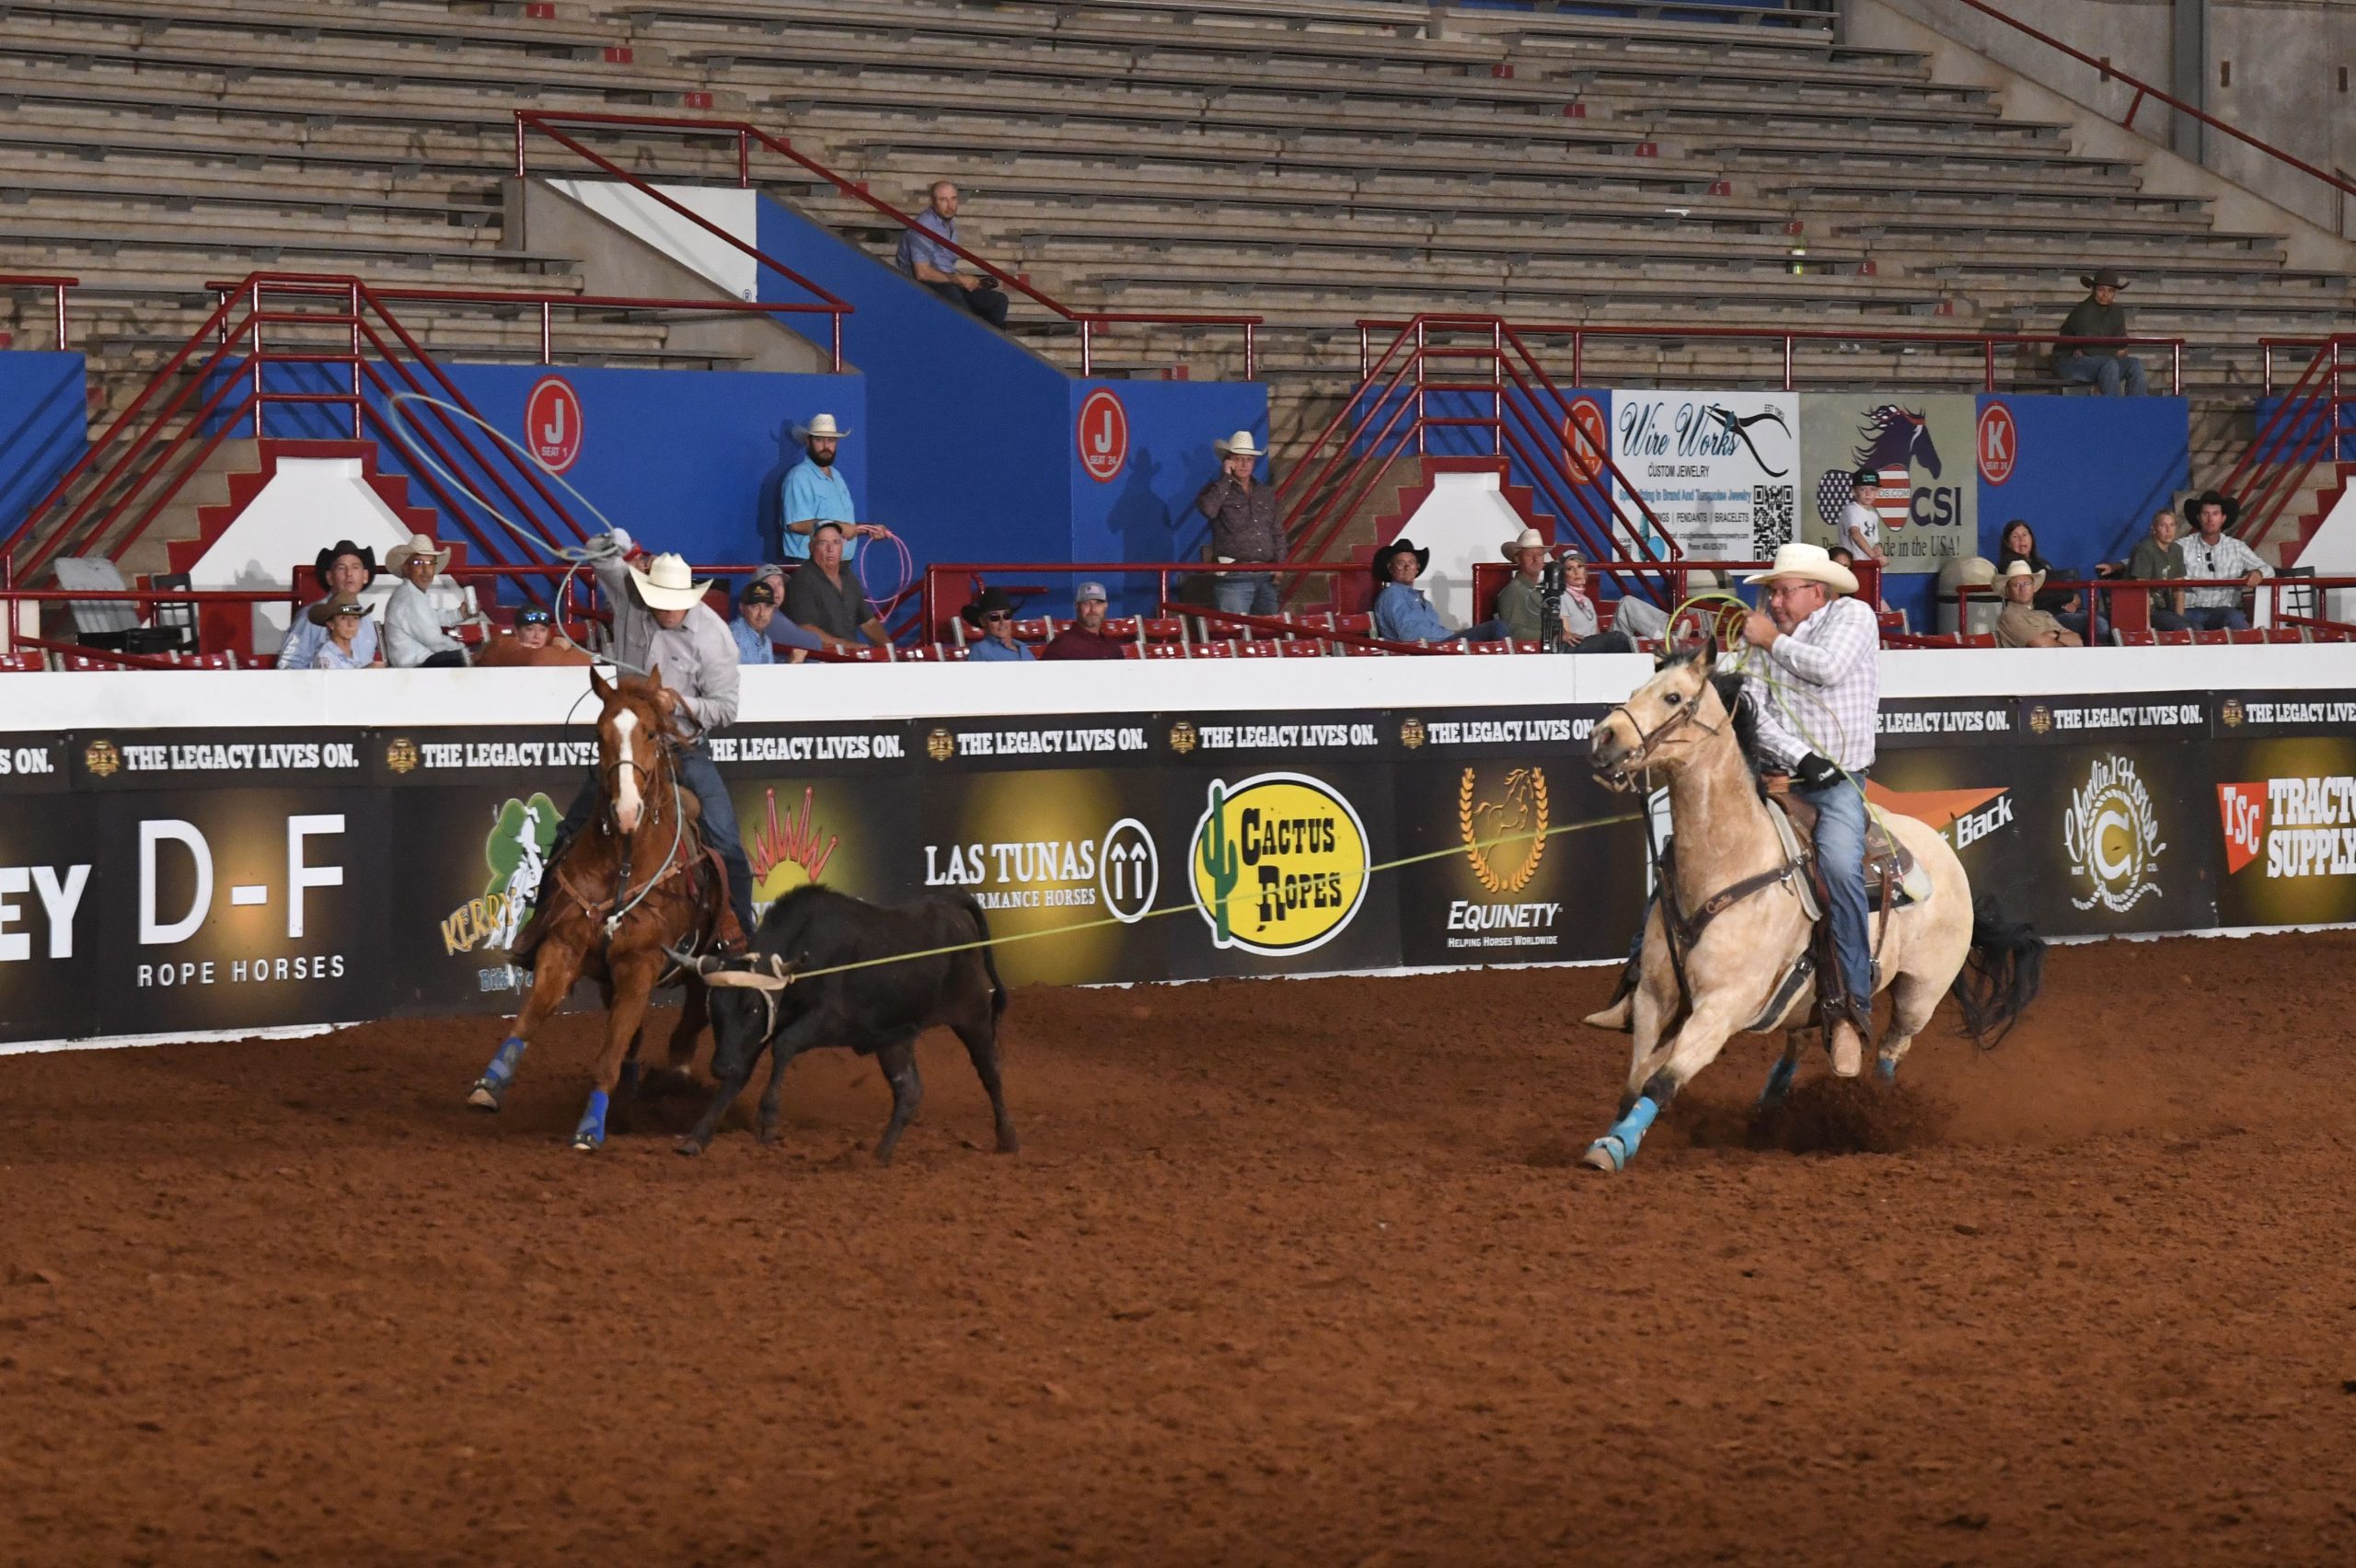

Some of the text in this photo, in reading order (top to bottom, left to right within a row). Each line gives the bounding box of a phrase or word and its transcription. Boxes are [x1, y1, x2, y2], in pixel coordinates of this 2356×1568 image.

[545, 398, 563, 444] J
[1095, 409, 1112, 453] J
[1620, 402, 1740, 456] Wire Works
[541, 446, 568, 456] SEAT 1
[1988, 421, 2006, 459] K
[1090, 455, 1106, 465] SEAT
[1648, 465, 1709, 477] CUSTOM JEWELRY
[1986, 462, 1999, 470] SEAT
[1681, 489, 1694, 501] And
[1728, 489, 1751, 503] Jewelry
[1911, 486, 1962, 526] CSI
[1677, 513, 1707, 523] PENDANTS
[1715, 513, 1750, 523] BRACELETS
[1899, 536, 1909, 558] in
[1912, 536, 1928, 558] the
[1931, 536, 1960, 558] USA!
[1887, 711, 1942, 733] LEGACY
[1943, 711, 1984, 732] LIVES
[1985, 710, 2010, 731] ON.
[2053, 704, 2203, 729] THE LEGACY LIVES ON.
[2246, 702, 2356, 723] THE LEGACY LIVE
[957, 728, 1148, 755] THE LEGACY LIVES ON.
[1199, 724, 1378, 748] THE LEGACY LIVES ON.
[1427, 719, 1595, 744] THE LEGACY LIVES ON
[16, 747, 54, 774] ON.
[122, 744, 359, 770] THE LEGACY LIVES ON.
[422, 742, 599, 767] THE LEGACY LIVES
[709, 735, 905, 762] HE LEGACY LIVES ON.
[2063, 760, 2113, 862] Charlie
[2117, 756, 2166, 857] Horse
[2223, 786, 2259, 855] TSC
[1957, 795, 2014, 850] Back
[2094, 810, 2131, 880] C
[2267, 828, 2356, 878] SUPPLY
[924, 839, 1095, 886] LAS TUNAS
[2072, 866, 2085, 875] HAT
[971, 888, 1095, 909] RMANCE HORSES
[441, 886, 517, 956] KERRY
[137, 955, 344, 987] ROPE HORSES
